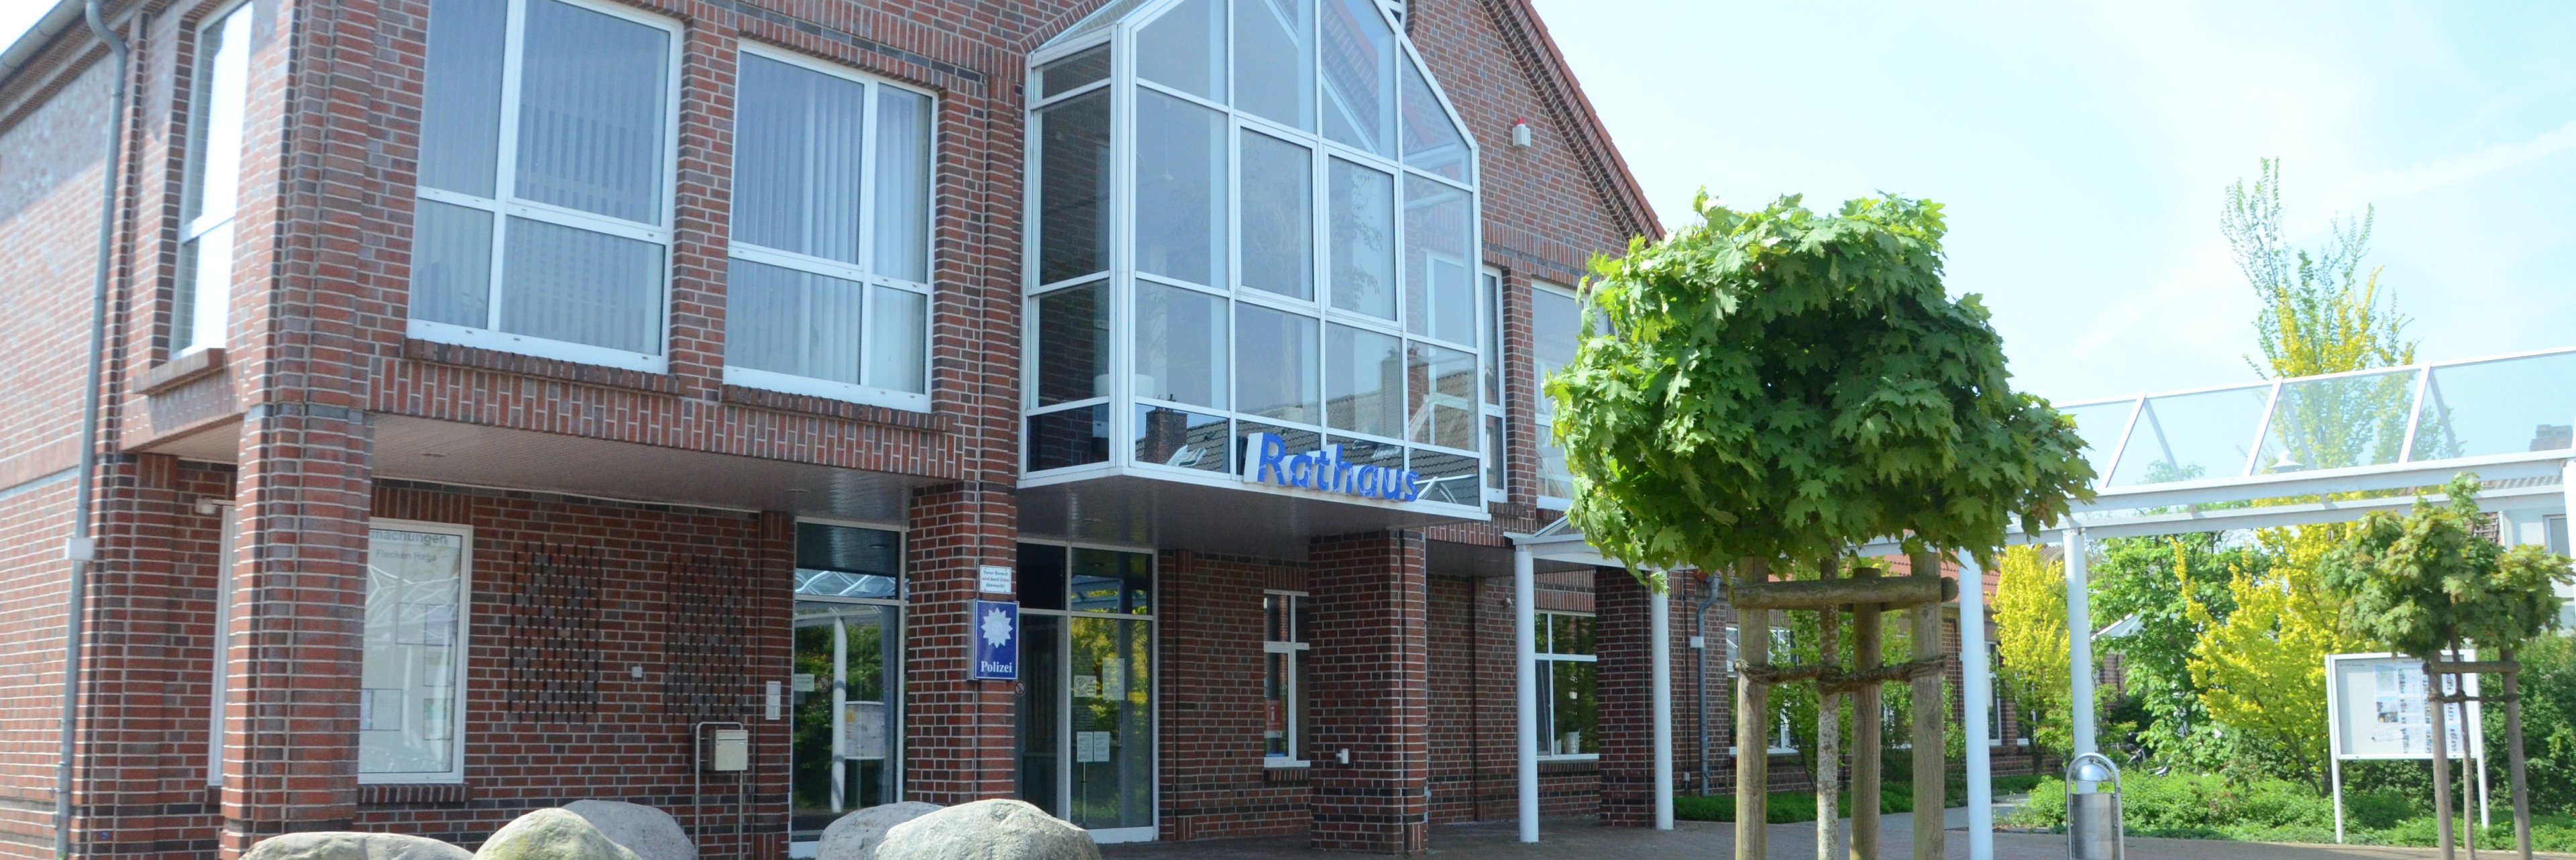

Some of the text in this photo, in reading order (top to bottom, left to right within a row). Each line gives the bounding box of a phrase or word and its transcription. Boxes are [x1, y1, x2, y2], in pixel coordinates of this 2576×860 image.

[1252, 432, 1421, 502] Rathaus
[370, 531, 447, 545] machungen
[980, 661, 1012, 673] Polizei
